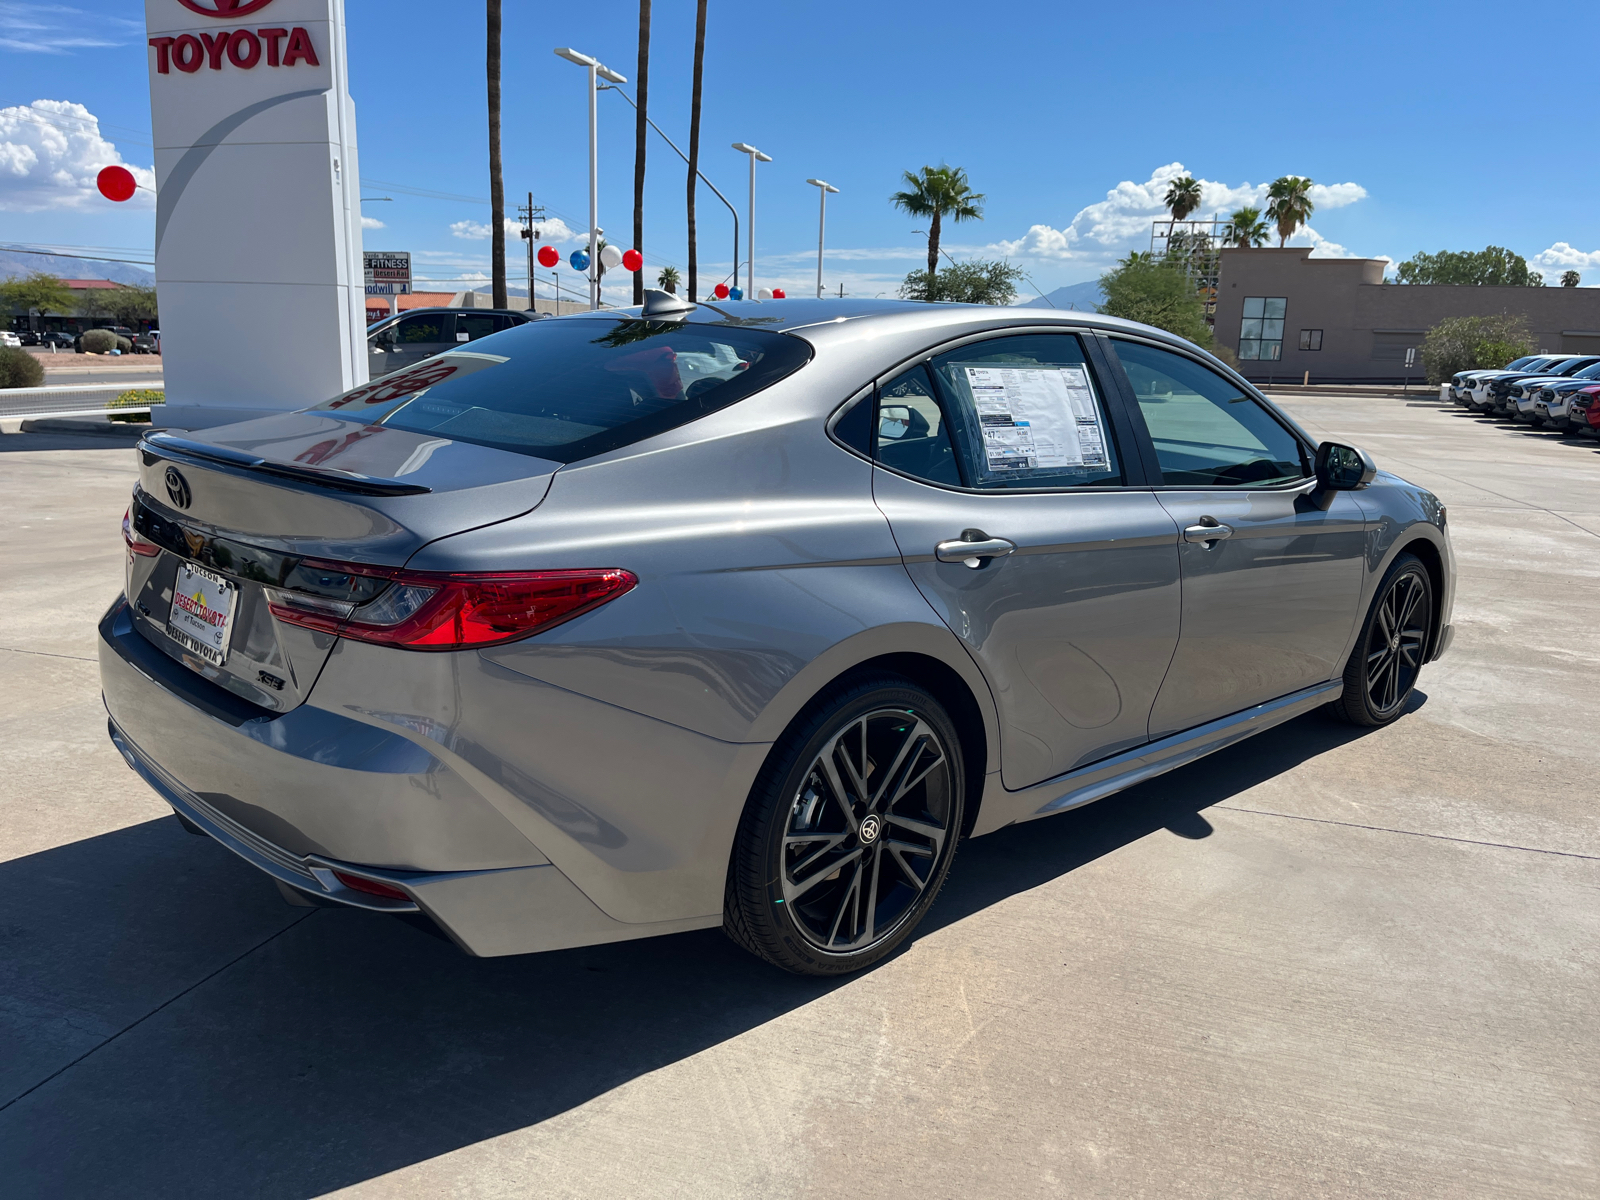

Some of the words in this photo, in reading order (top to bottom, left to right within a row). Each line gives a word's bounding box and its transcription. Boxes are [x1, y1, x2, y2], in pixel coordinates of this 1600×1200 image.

[148, 27, 320, 75] TOYOTA
[371, 259, 408, 268] FITNESS
[191, 563, 219, 583] TUCSON
[174, 591, 198, 613] DESERT
[198, 604, 228, 628] TOYOTA
[190, 616, 206, 631] Tucson
[167, 624, 189, 646] DESERT
[189, 637, 217, 663] TOYOTA
[255, 670, 285, 690] XSE
